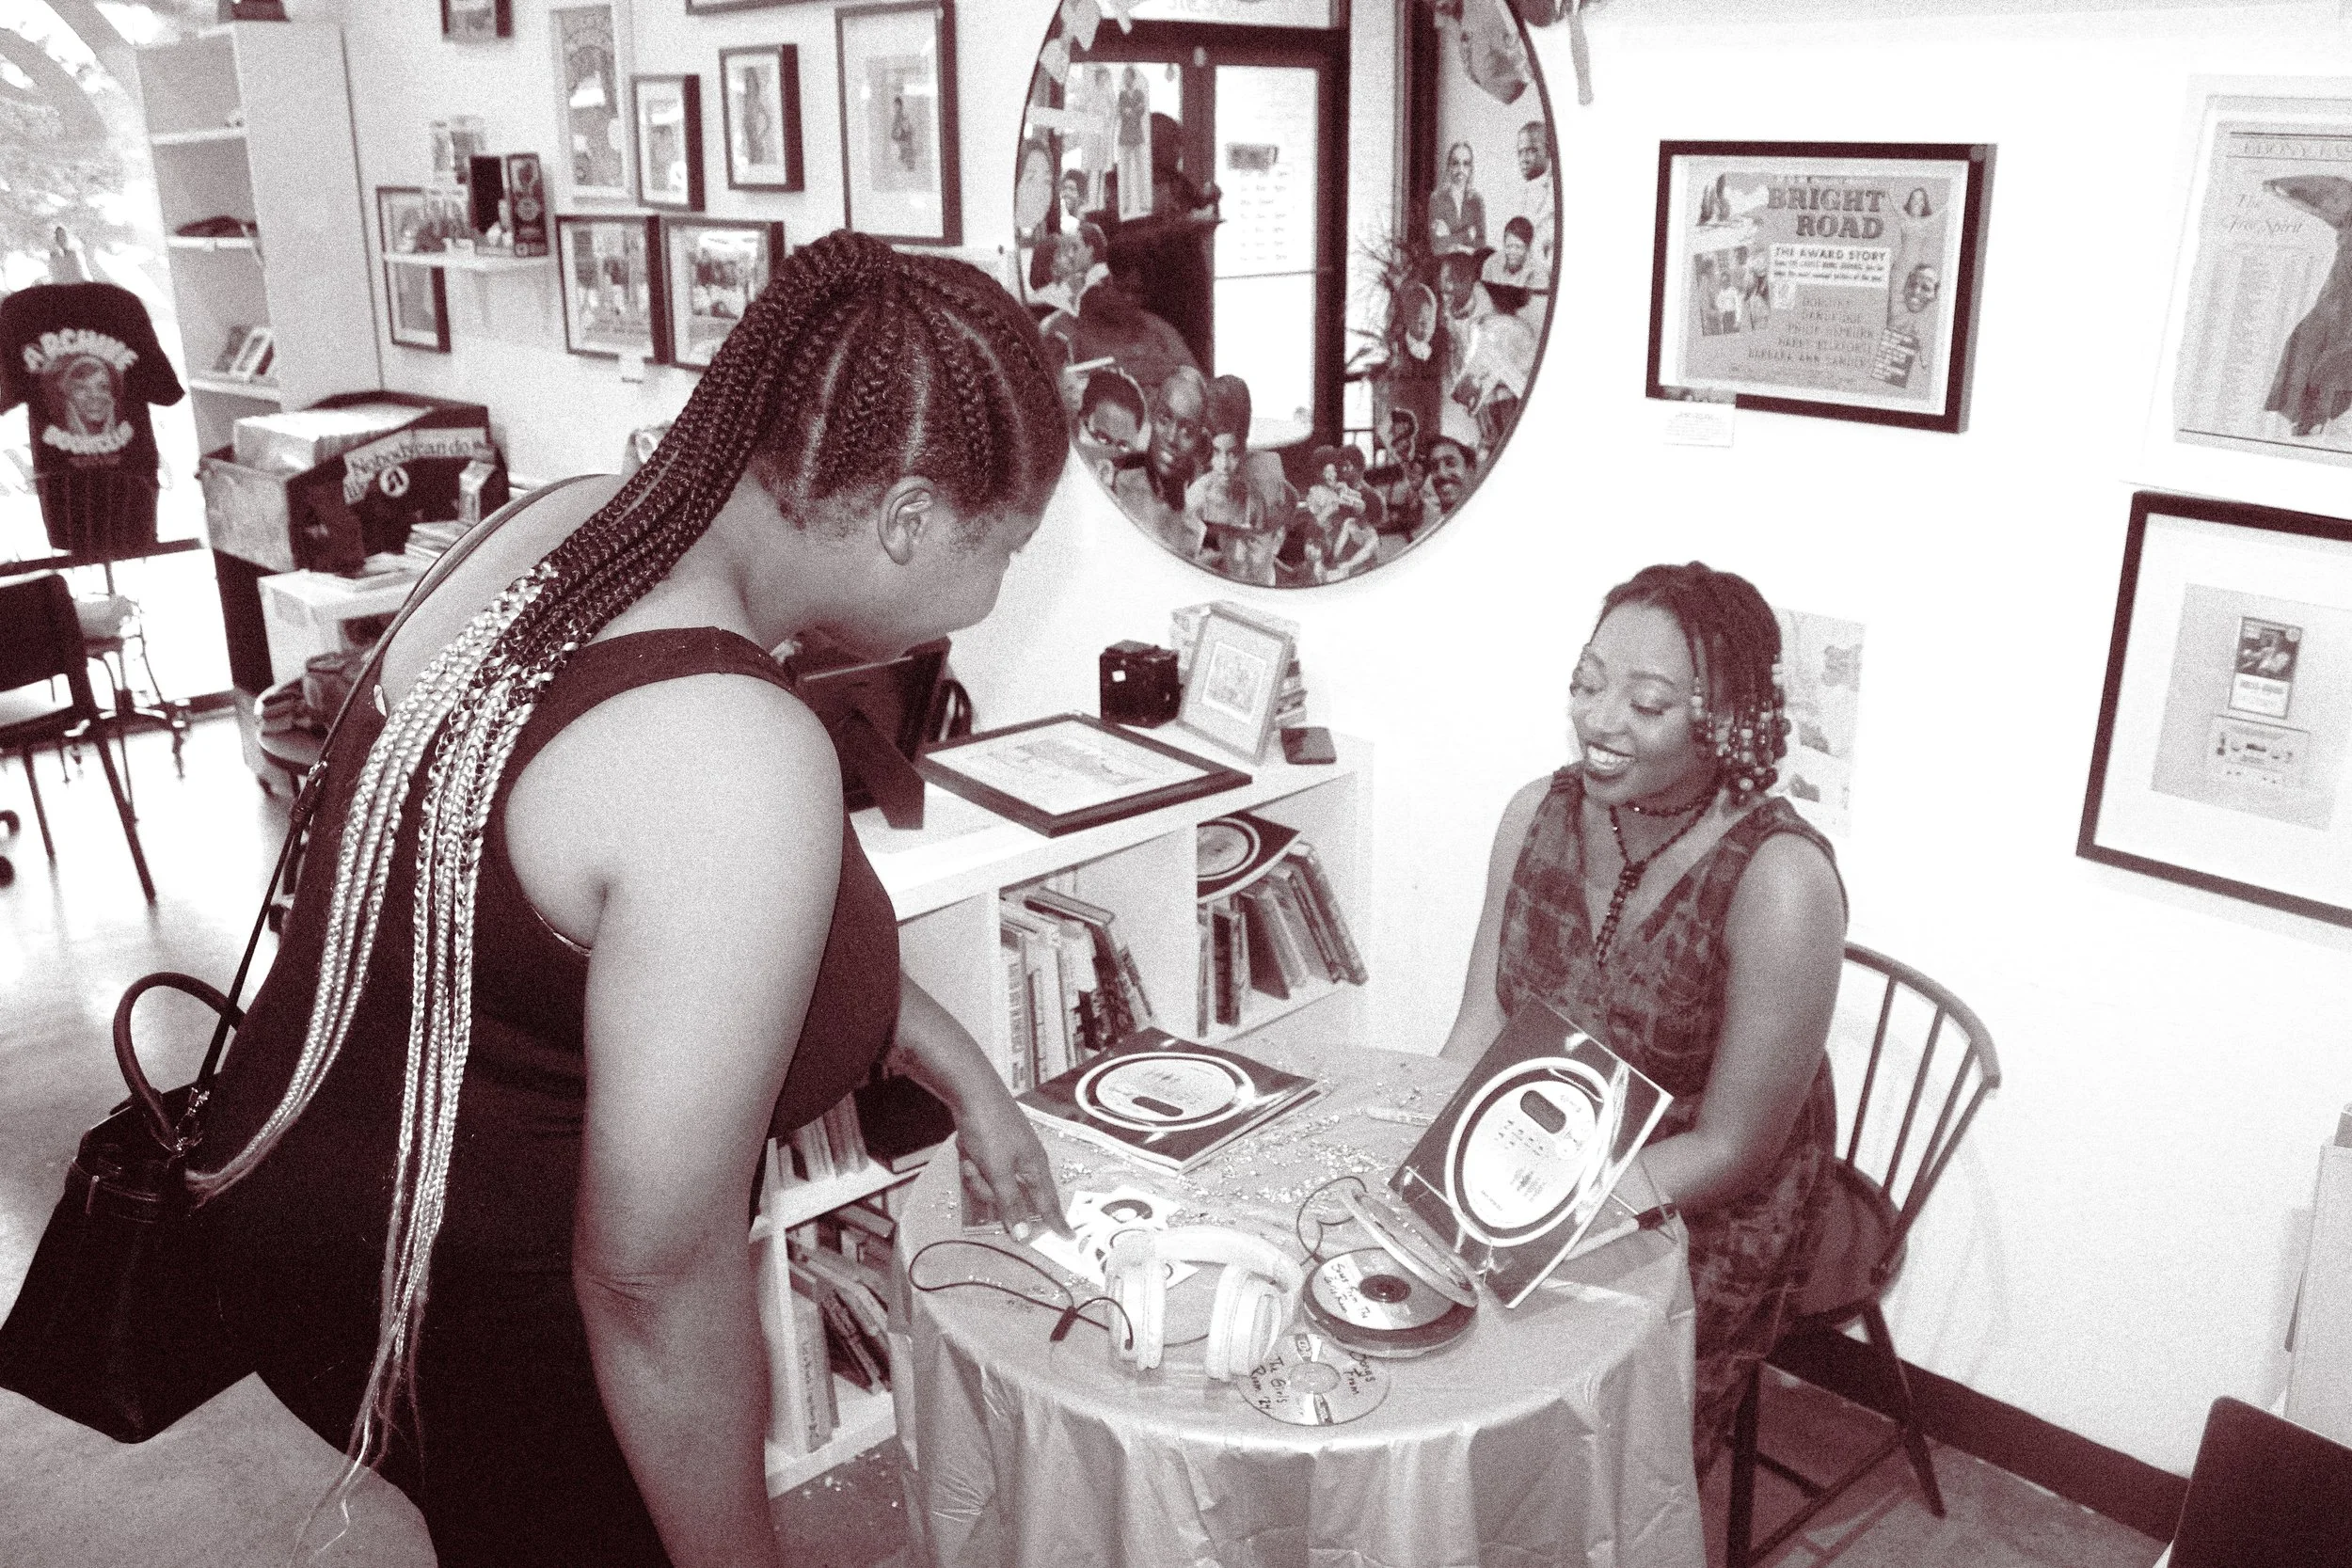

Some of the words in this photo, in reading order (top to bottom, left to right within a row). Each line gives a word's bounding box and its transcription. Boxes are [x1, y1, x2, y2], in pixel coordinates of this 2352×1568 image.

[1767, 187, 1885, 213] BRIGHT
[1796, 214, 1884, 240] ROAD
[1800, 248, 1844, 260] AWARD
[1849, 250, 1886, 261] STORY
